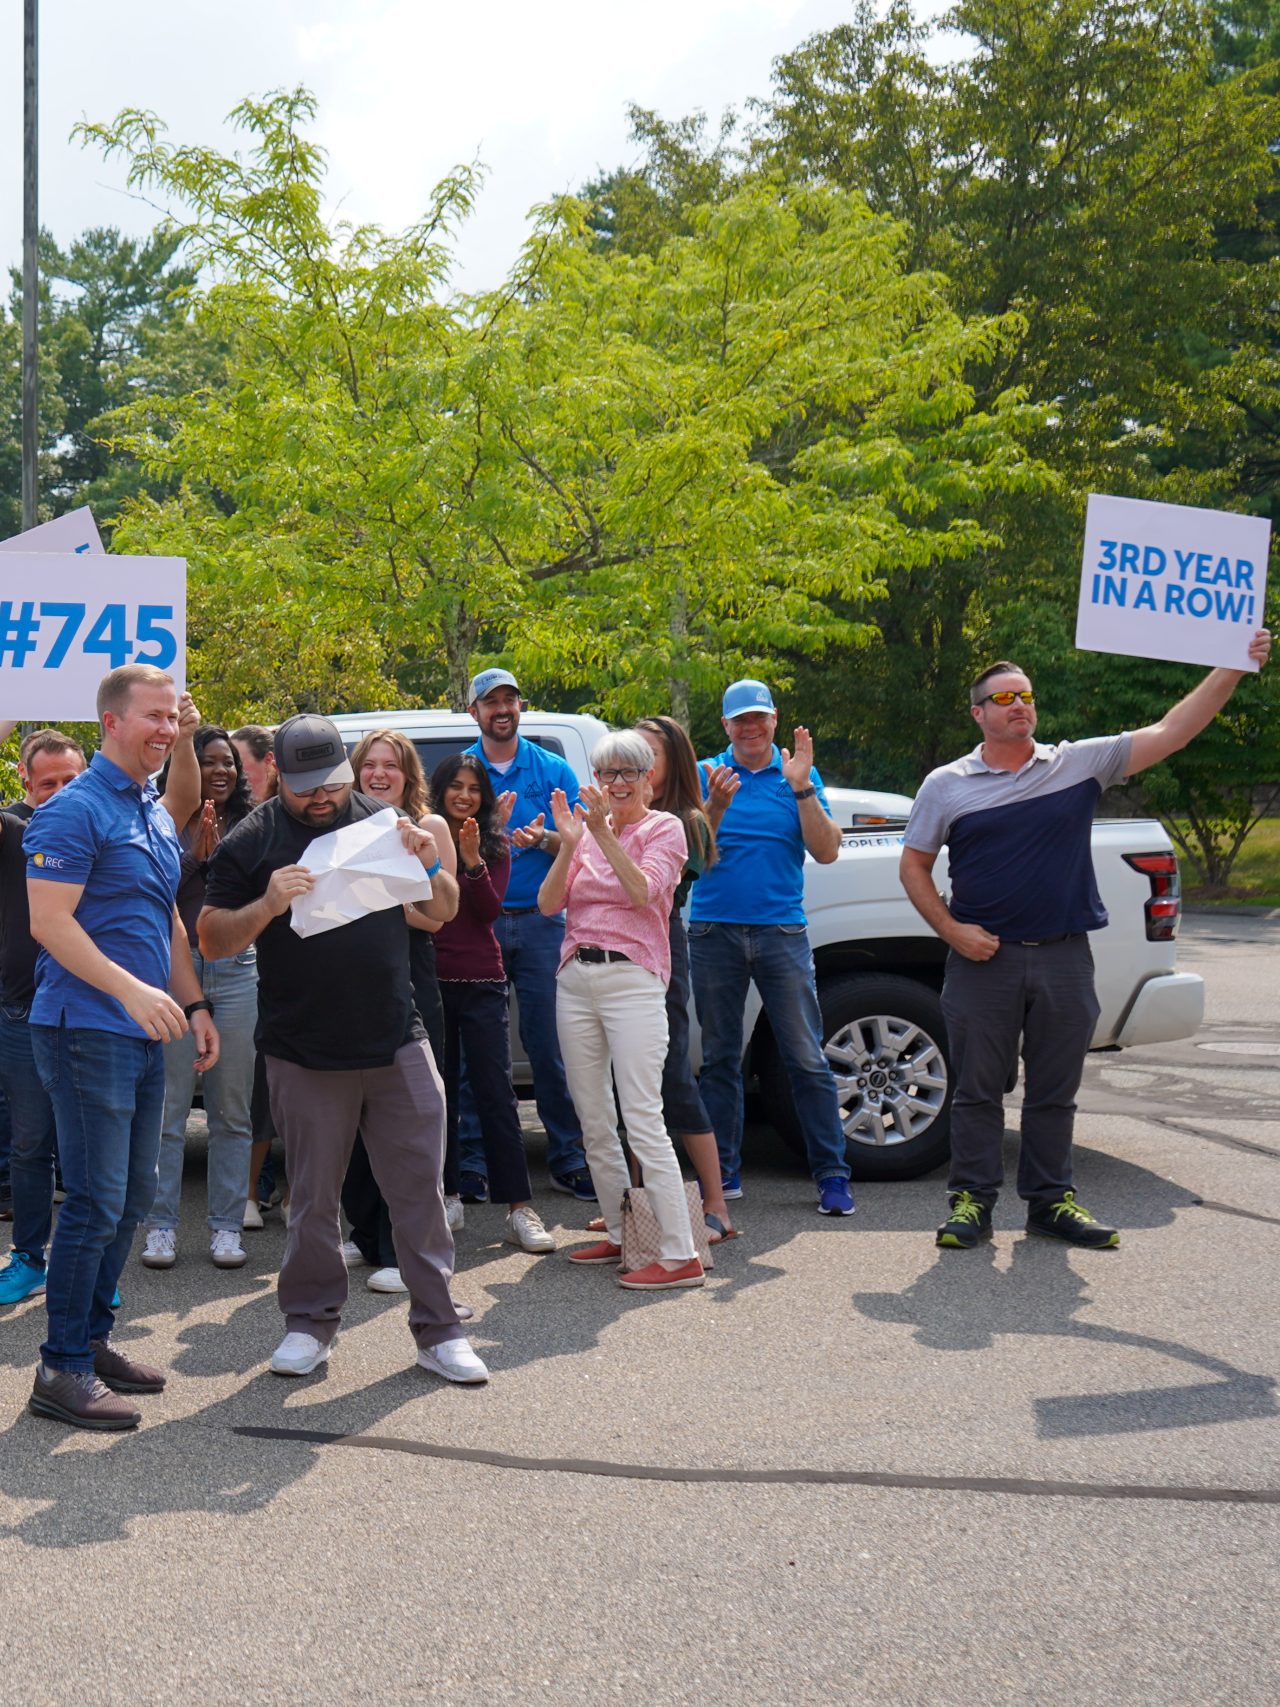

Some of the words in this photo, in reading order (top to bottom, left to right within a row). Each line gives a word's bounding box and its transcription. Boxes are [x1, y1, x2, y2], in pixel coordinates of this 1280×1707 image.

[1097, 539, 1167, 577] 3RD
[1173, 549, 1255, 591] YEAR
[1091, 573, 1128, 608] IN
[1132, 580, 1157, 612] A
[1164, 583, 1255, 625] ROW!
[841, 837, 890, 849] EOPLE!
[45, 856, 64, 869] REC
